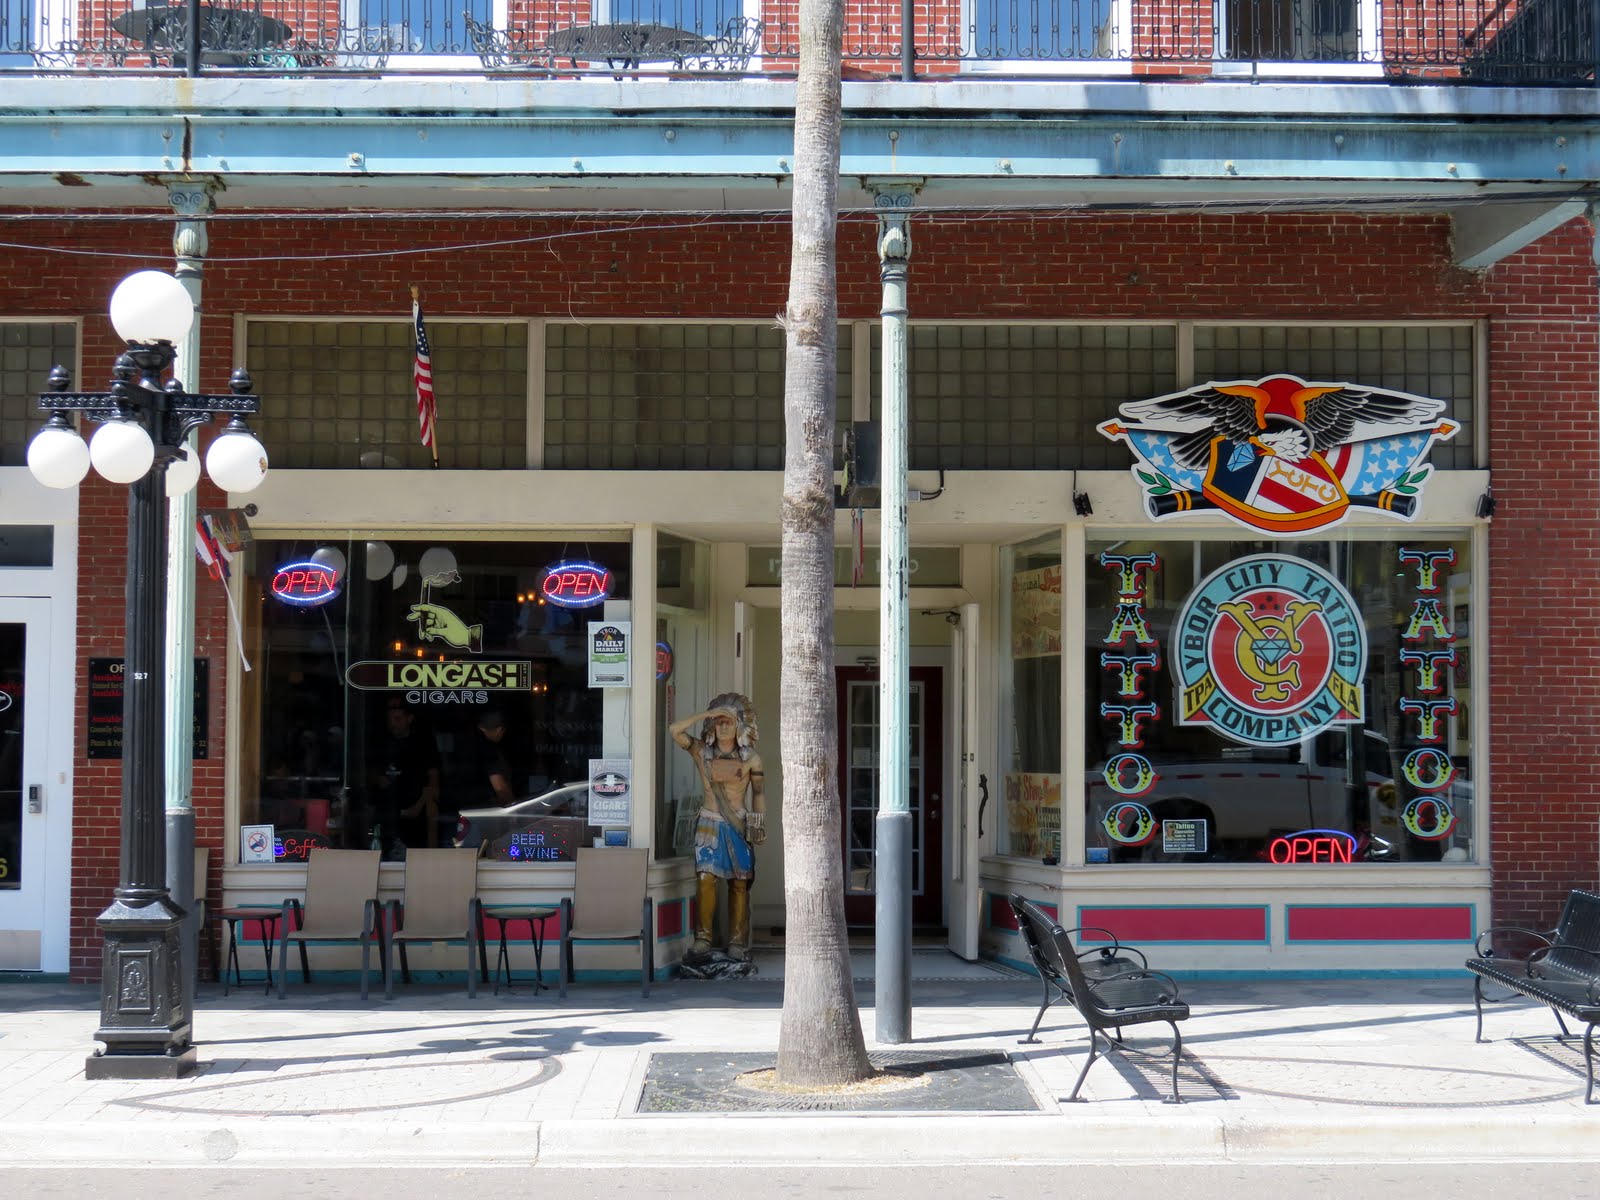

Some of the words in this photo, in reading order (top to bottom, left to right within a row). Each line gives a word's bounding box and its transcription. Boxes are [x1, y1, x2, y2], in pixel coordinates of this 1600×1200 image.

[272, 570, 337, 593] OPEN
[543, 573, 608, 595] OPEN
[1184, 595, 1218, 671] YBOR
[1225, 563, 1284, 593] CITY
[1302, 572, 1358, 668] TATTOO
[595, 640, 624, 648] DAILY
[109, 664, 125, 673] OF
[405, 690, 489, 704] CIGARS
[1100, 551, 1160, 847] TATTOO
[1184, 678, 1212, 713] TPA
[1332, 676, 1359, 713] FLA
[1399, 547, 1459, 841] TATTOO
[1207, 694, 1334, 739] COMPANY
[593, 800, 627, 811] CIGARS
[285, 838, 328, 858] Coff
[511, 833, 545, 846] BEER
[509, 845, 520, 857] &
[523, 847, 559, 859] WINE
[1270, 838, 1352, 864] OPEN
